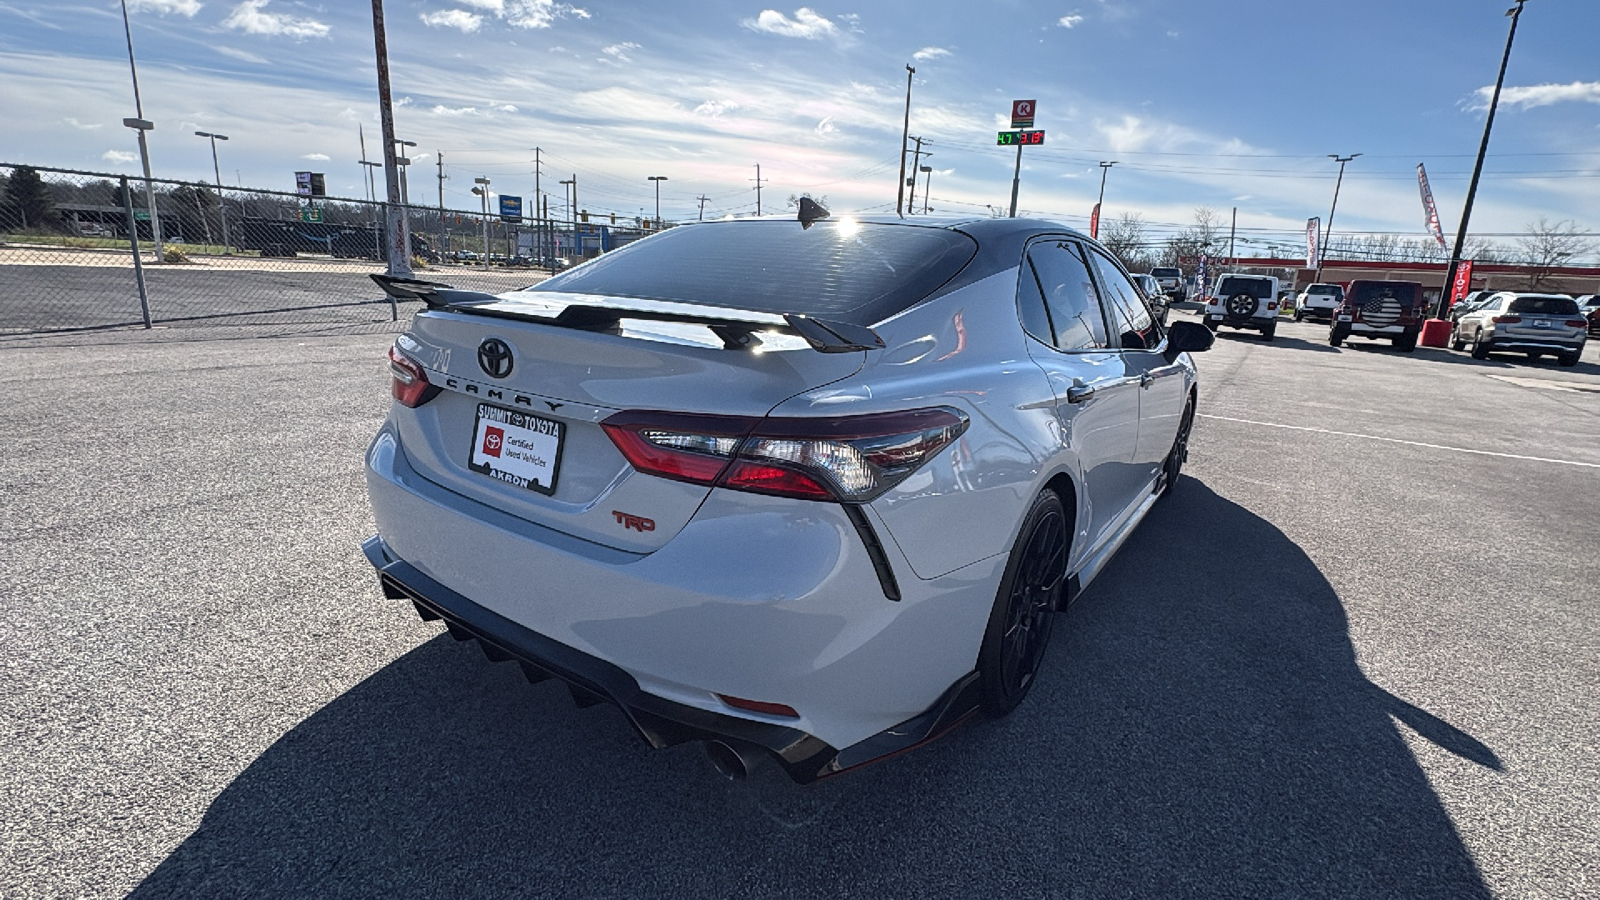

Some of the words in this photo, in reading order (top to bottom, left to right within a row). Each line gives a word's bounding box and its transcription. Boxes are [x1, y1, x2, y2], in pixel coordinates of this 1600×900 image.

[446, 378, 564, 412] CAMRY
[478, 404, 512, 424] SUMMIT
[524, 415, 559, 438] TOYOTA
[506, 436, 534, 451] Certified
[505, 447, 521, 460] Used
[521, 451, 547, 468] Vehicles
[489, 469, 529, 488] AKRON
[612, 510, 655, 532] TRD
